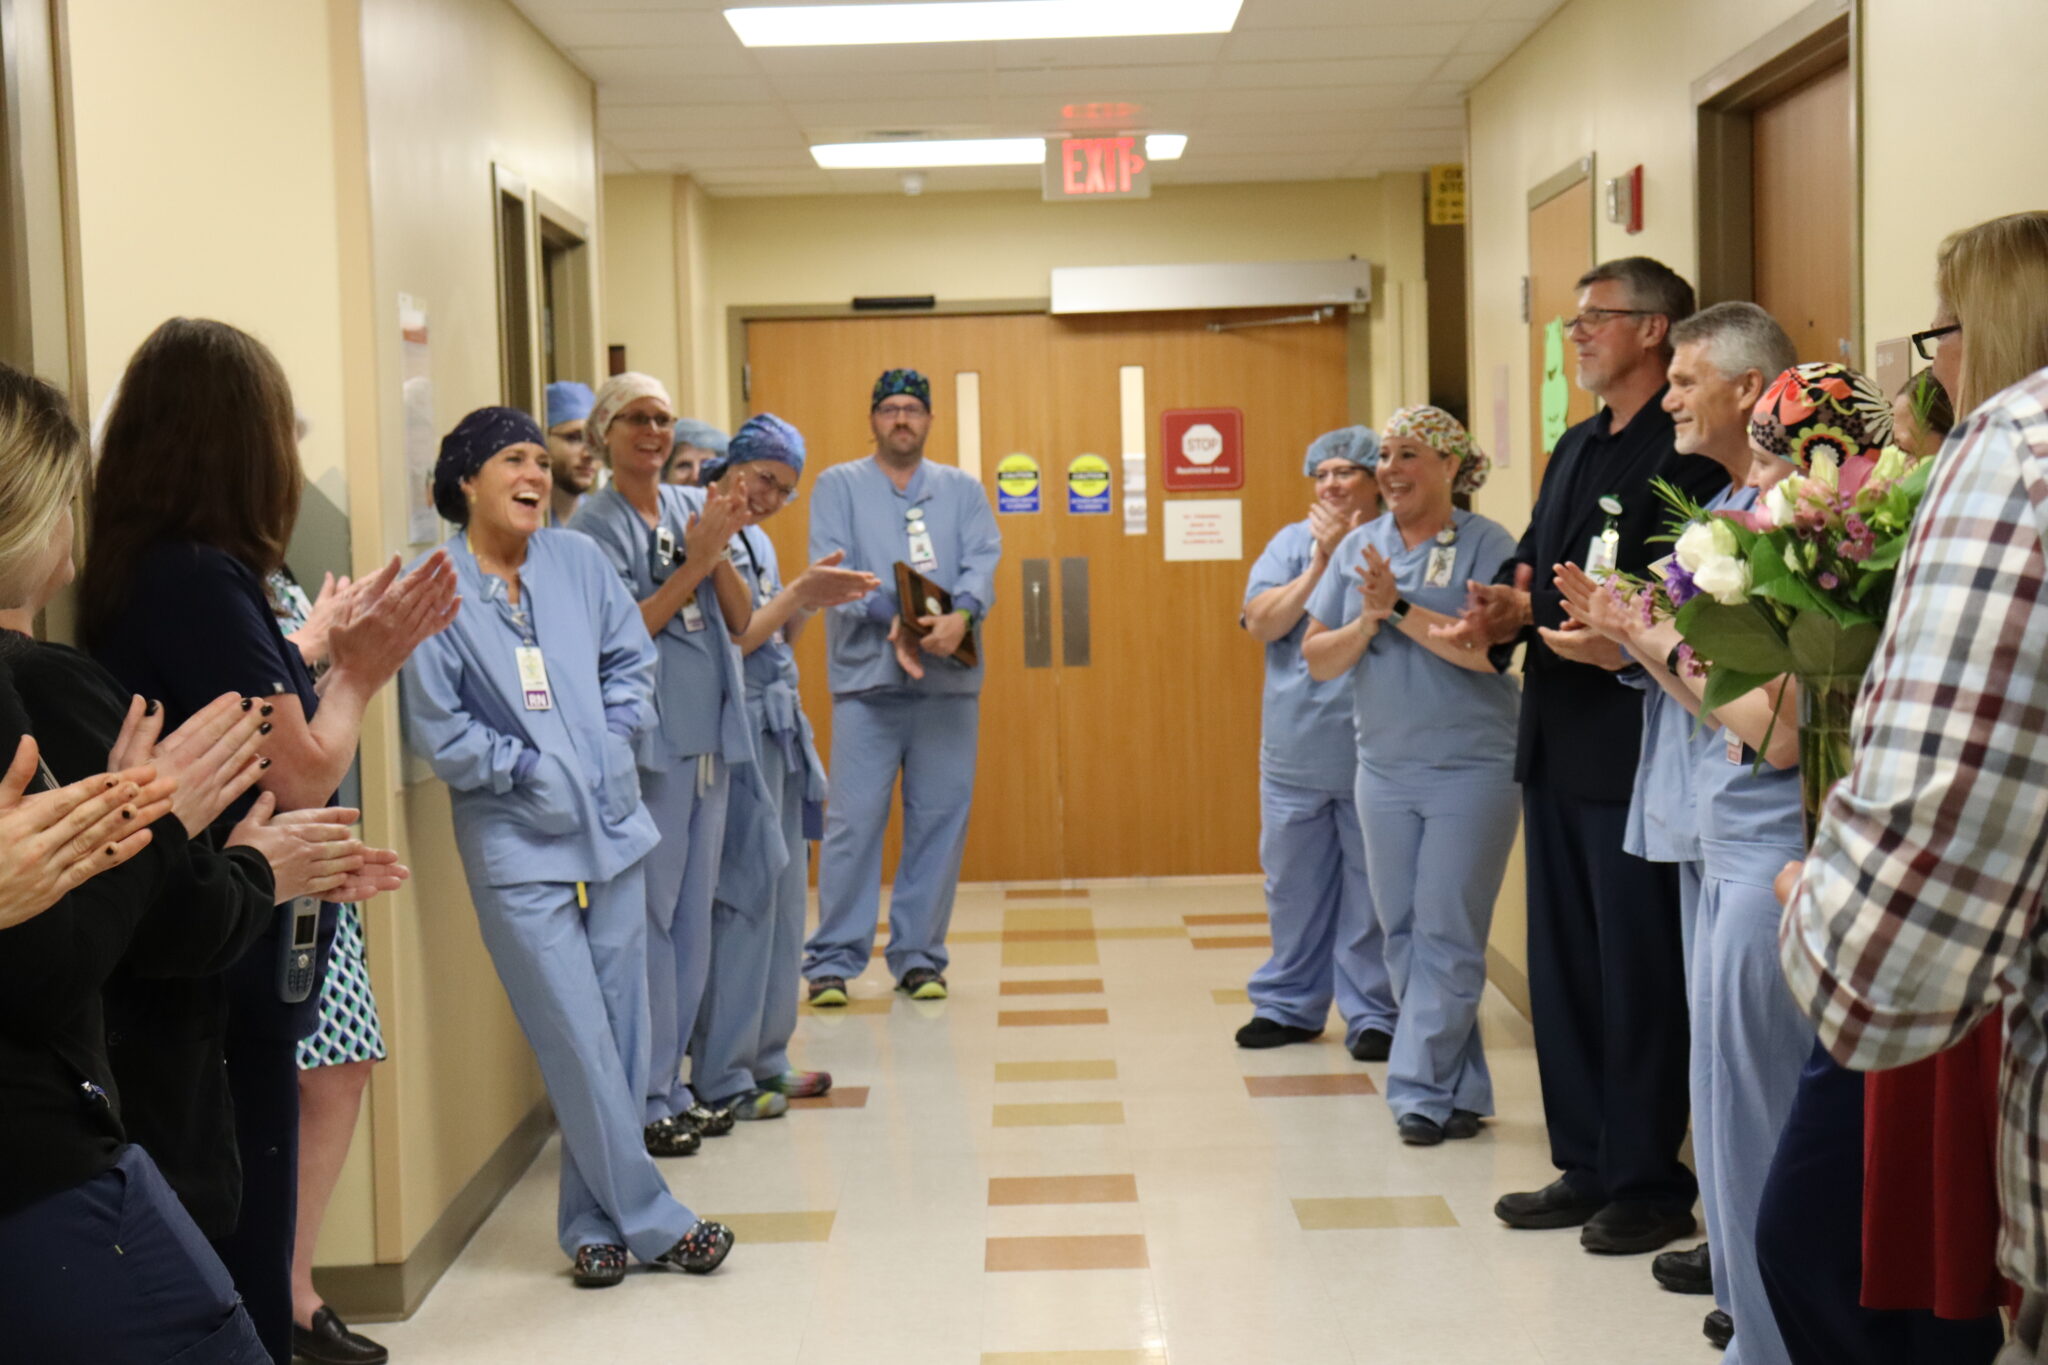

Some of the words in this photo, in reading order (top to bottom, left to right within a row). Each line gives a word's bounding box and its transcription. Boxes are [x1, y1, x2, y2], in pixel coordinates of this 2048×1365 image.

[1062, 137, 1135, 194] EXIT
[1187, 438, 1218, 451] STOP
[528, 693, 548, 707] RN
